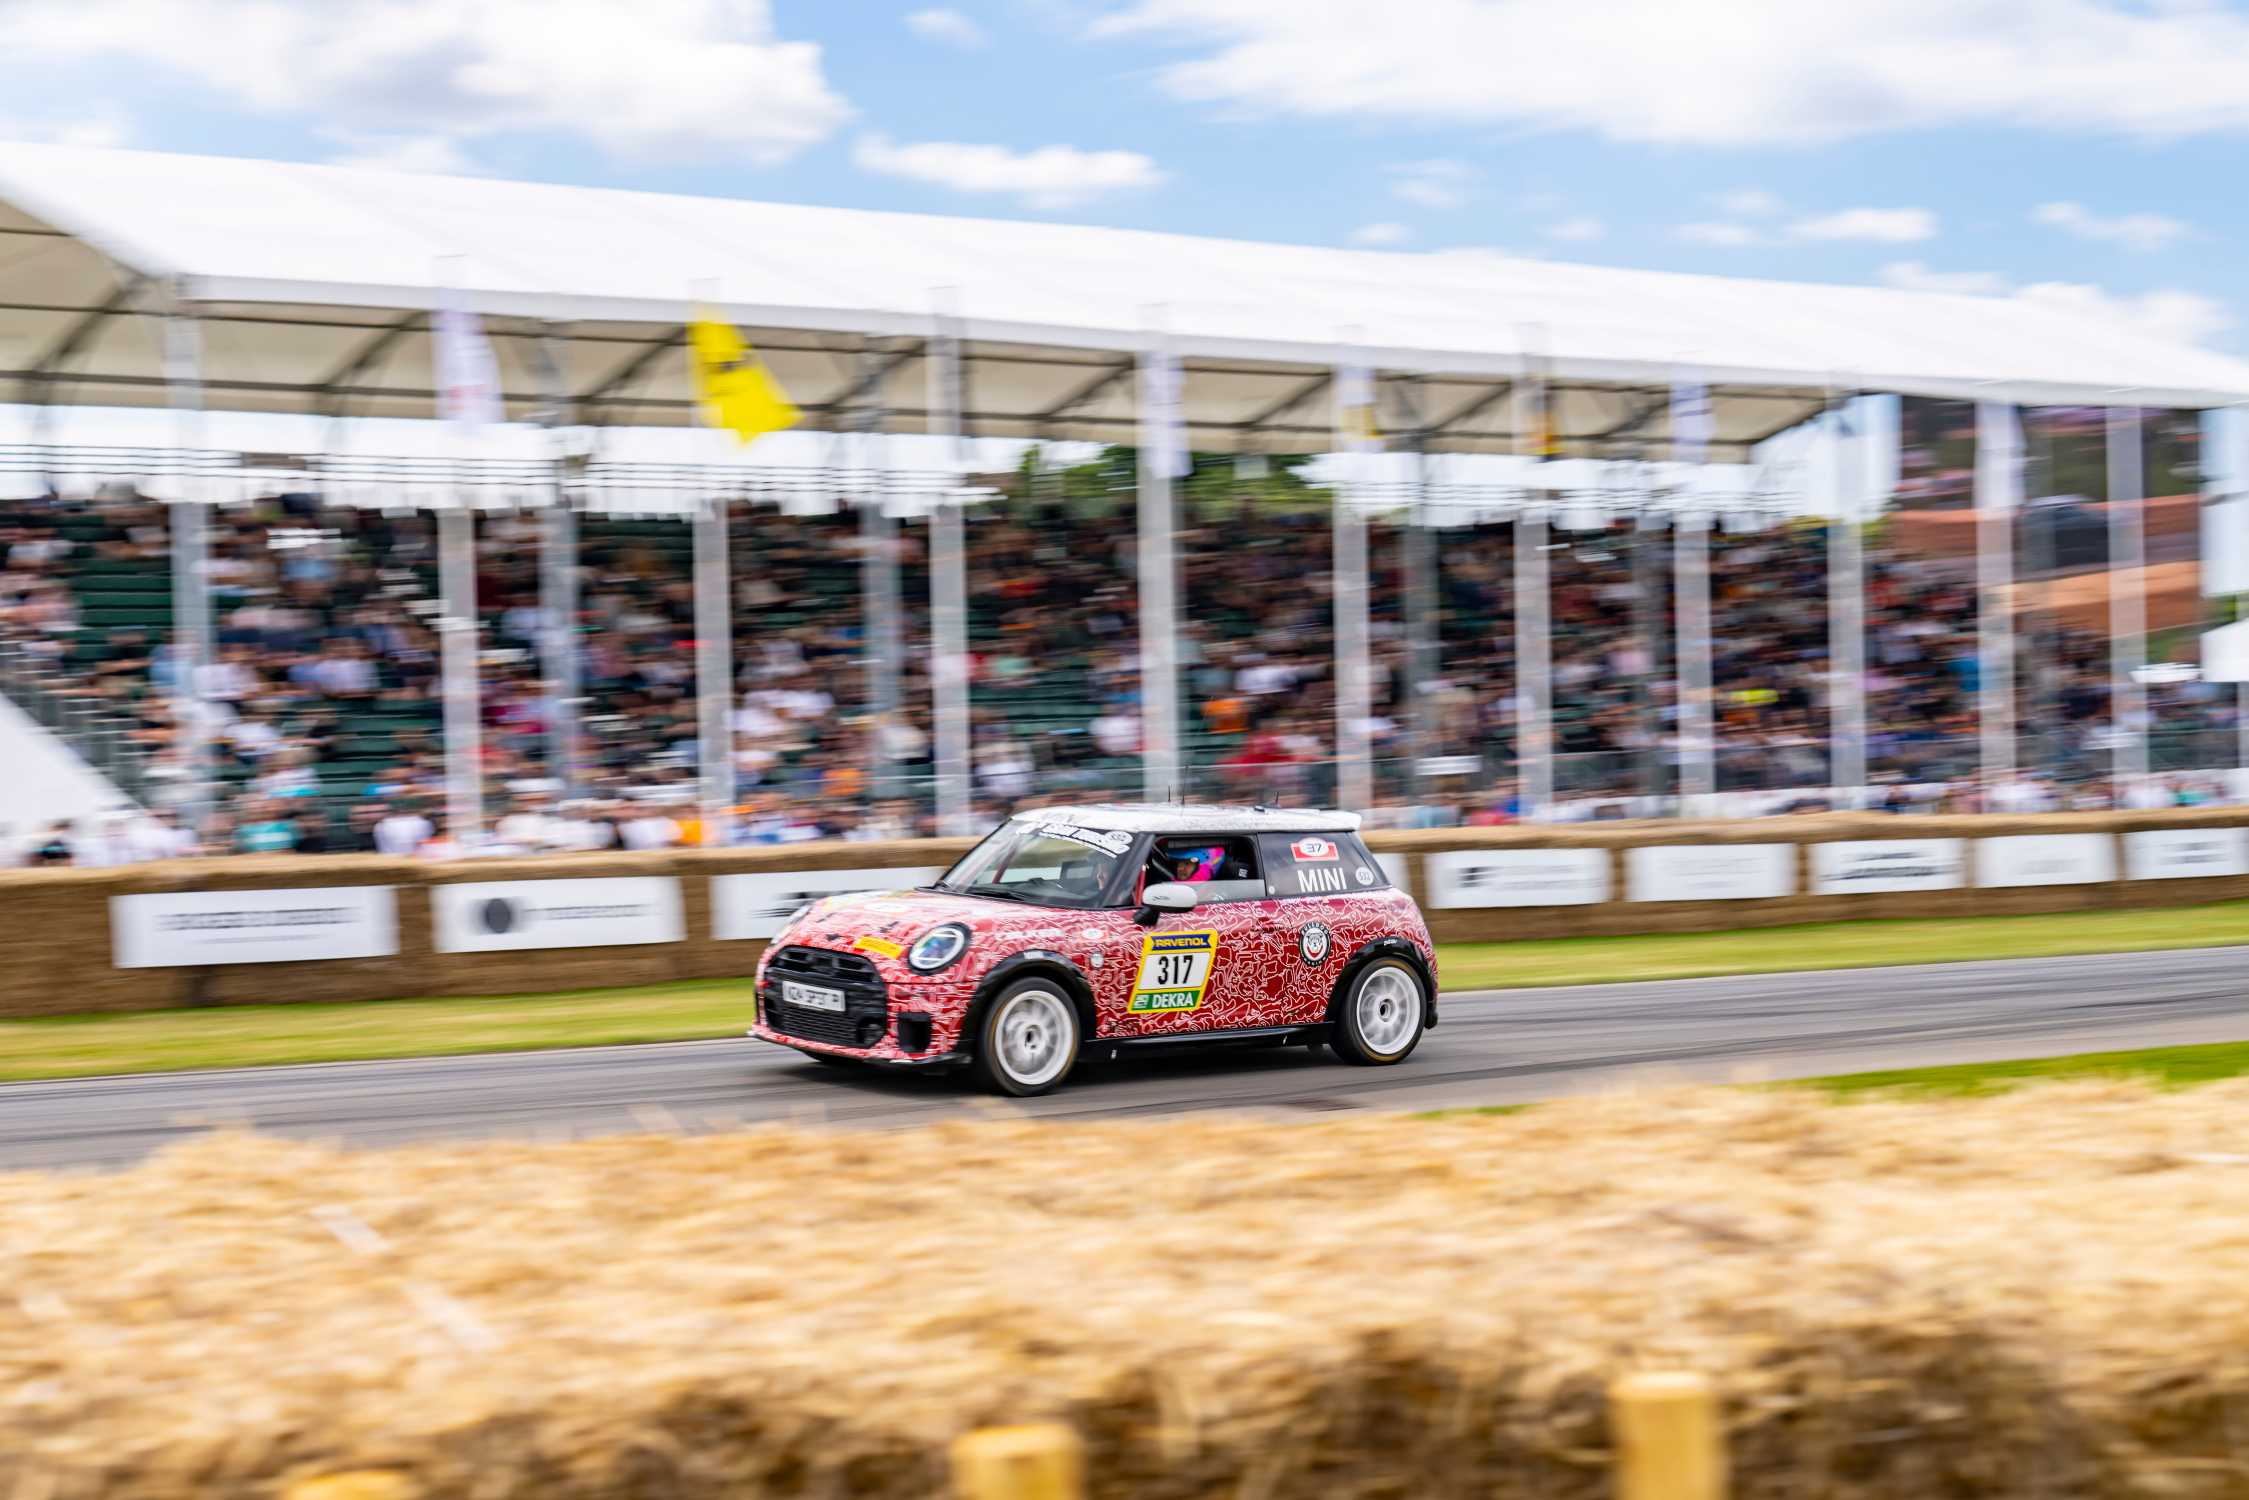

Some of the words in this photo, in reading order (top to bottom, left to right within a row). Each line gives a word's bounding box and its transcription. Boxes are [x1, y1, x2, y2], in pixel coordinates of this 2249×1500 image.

[1297, 867, 1347, 893] MINI
[1154, 937, 1207, 947] RAVENOL
[1157, 955, 1194, 985] 317
[1151, 992, 1194, 1009] DEKRA
